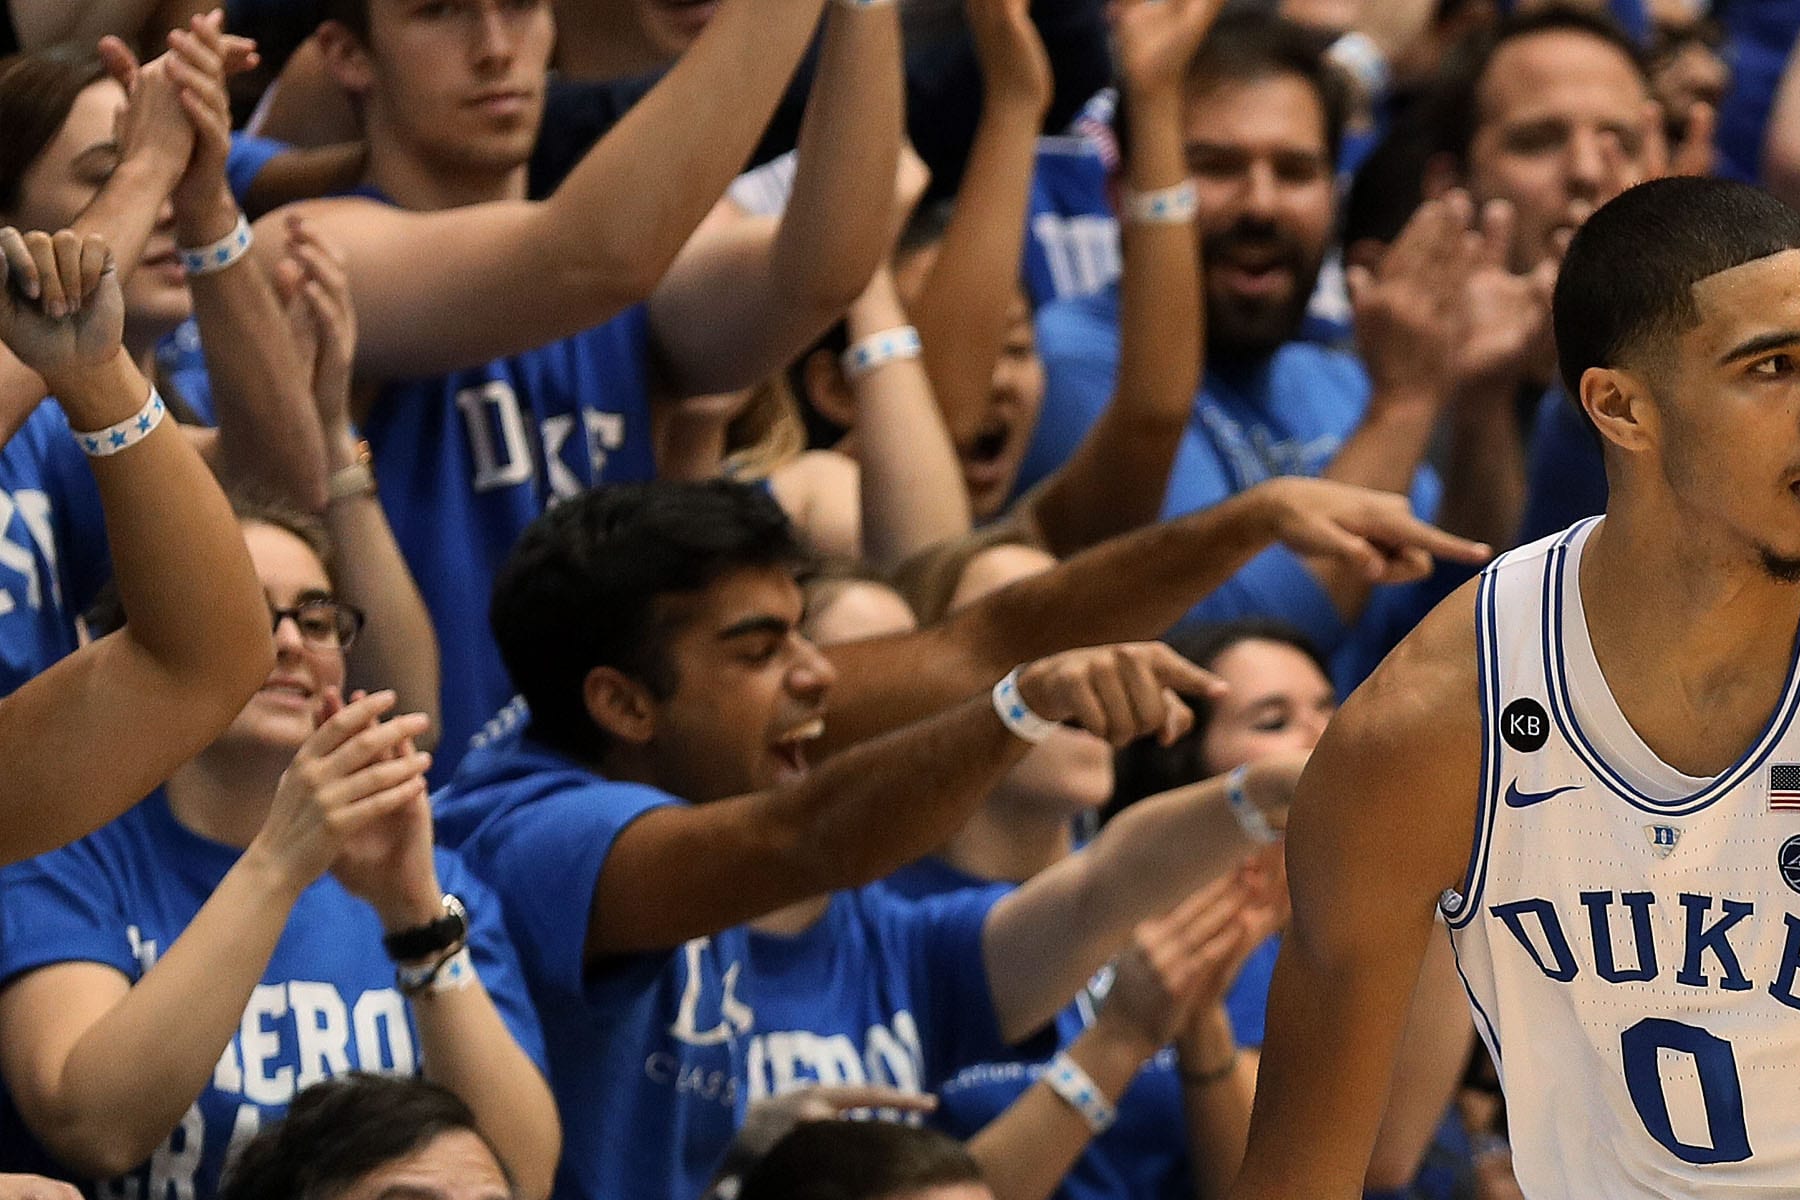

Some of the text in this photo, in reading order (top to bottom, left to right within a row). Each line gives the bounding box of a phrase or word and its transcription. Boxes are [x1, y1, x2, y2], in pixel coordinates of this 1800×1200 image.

[455, 380, 625, 510] DKE
[1509, 713, 1541, 737] KB
[1620, 1016, 1755, 1165] 0
